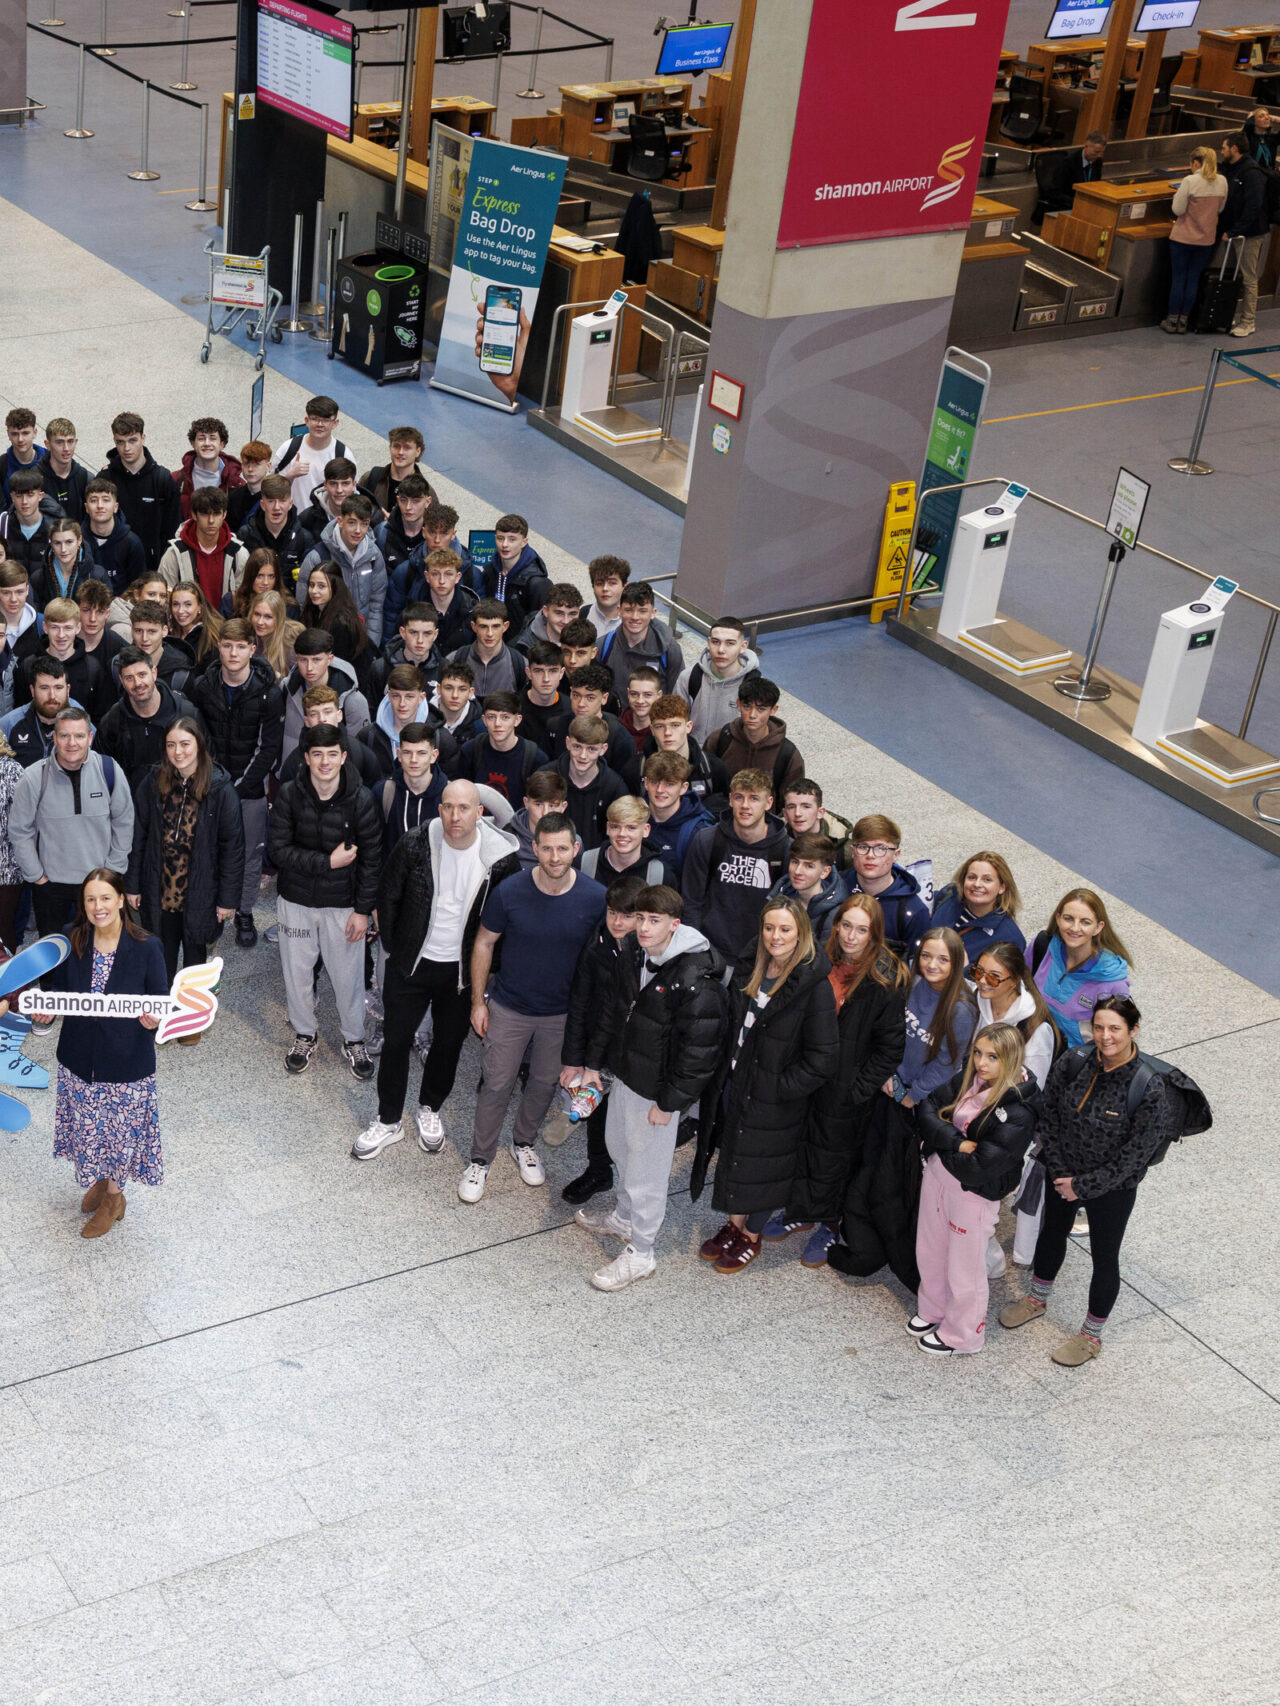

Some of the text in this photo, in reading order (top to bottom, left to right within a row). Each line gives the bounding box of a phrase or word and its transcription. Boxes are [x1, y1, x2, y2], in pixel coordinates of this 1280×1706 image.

[1061, 17, 1095, 28] Bag Drop
[1152, 11, 1184, 21] Check-in
[675, 56, 719, 67] Business Class
[510, 164, 546, 179] Aer Lingus
[478, 176, 493, 184] STEP
[814, 176, 934, 200] shannon AIRPORT
[472, 186, 520, 215] Express
[470, 211, 536, 242] Bag Drop
[466, 233, 536, 259] Use the Aer Lingus
[464, 248, 536, 274] app to tag your bag.
[938, 418, 951, 432] Does
[891, 528, 911, 538] CAUTION
[732, 854, 756, 868] THE
[717, 862, 754, 876] ORTH
[720, 872, 752, 886] FACE
[24, 994, 171, 1015] shannon AIRPORT
